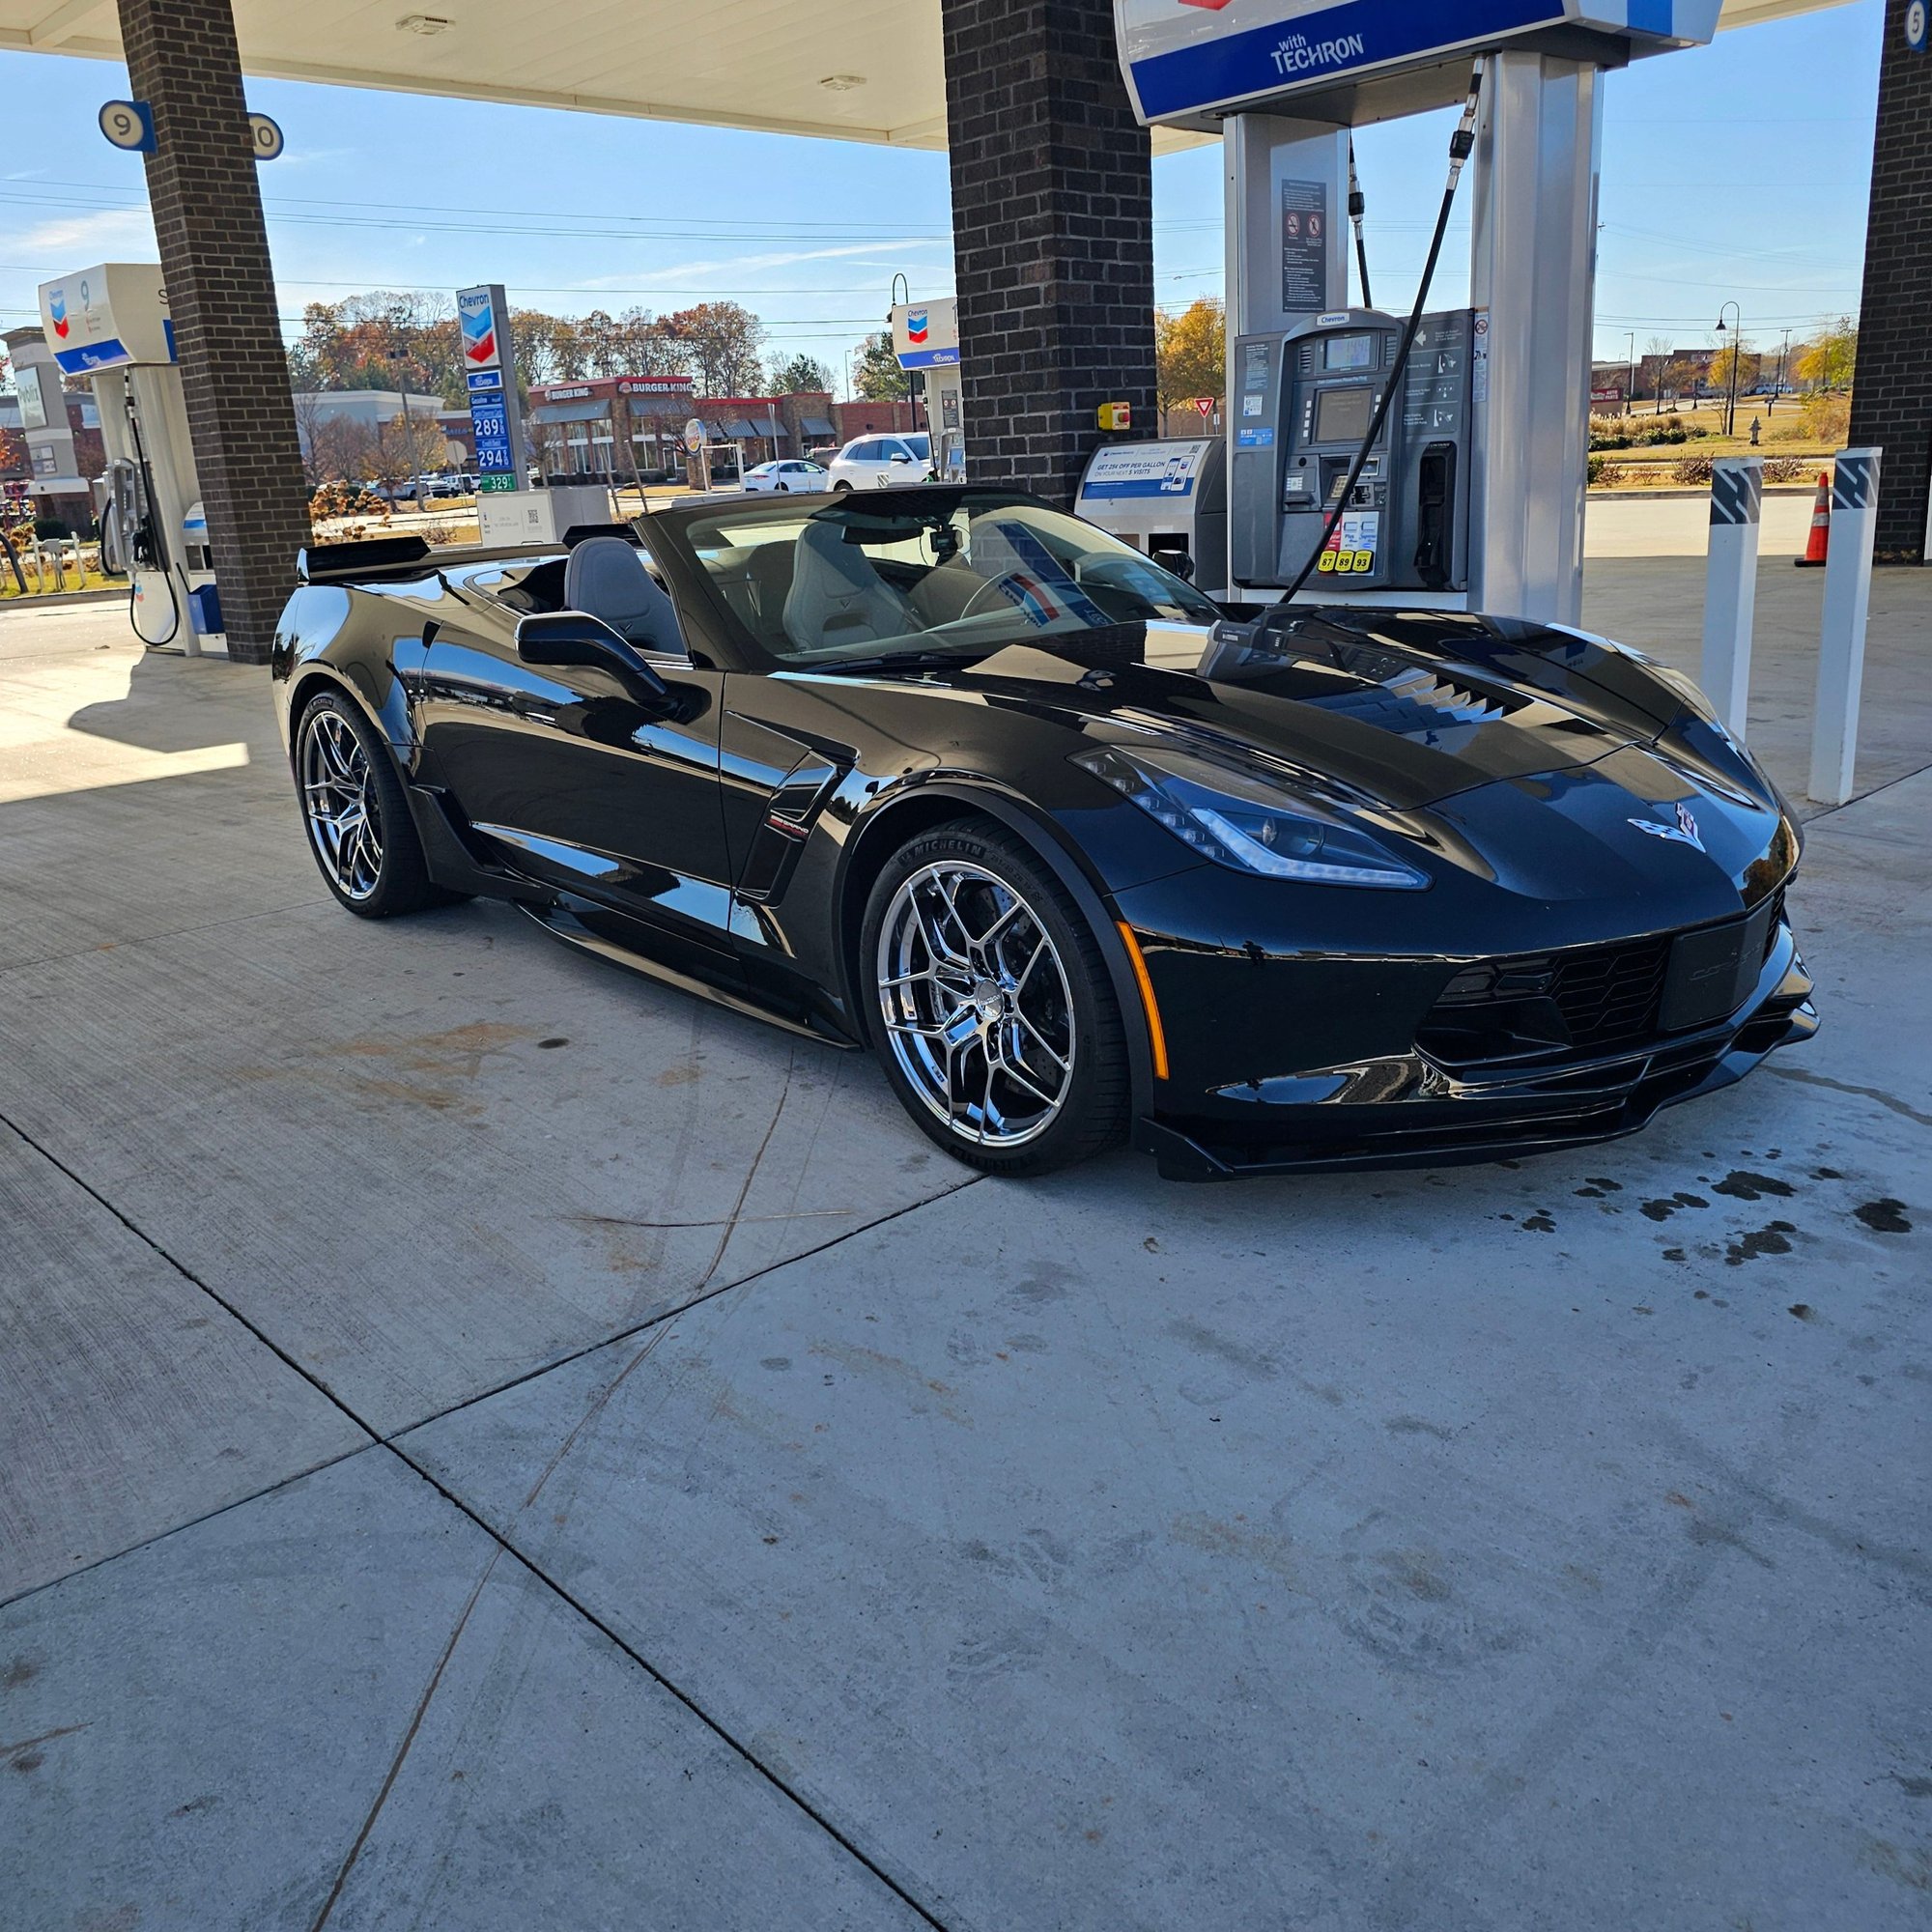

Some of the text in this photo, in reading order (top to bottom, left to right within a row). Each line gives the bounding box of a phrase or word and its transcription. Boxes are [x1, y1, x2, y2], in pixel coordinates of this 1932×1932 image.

[1278, 34, 1306, 52] with
[1270, 34, 1364, 74] TECHRON
[113, 114, 131, 136] 9
[80, 280, 90, 312] 9
[459, 294, 490, 309] Chevron
[1321, 315, 1345, 324] Chevron
[552, 387, 589, 400] BURGER KING
[632, 383, 693, 392] BURGER KING
[474, 418, 498, 437] 289
[478, 449, 503, 468] 294
[491, 476, 508, 489] 329
[1356, 558, 1367, 567] 93
[915, 838, 981, 857] MICHELIN
